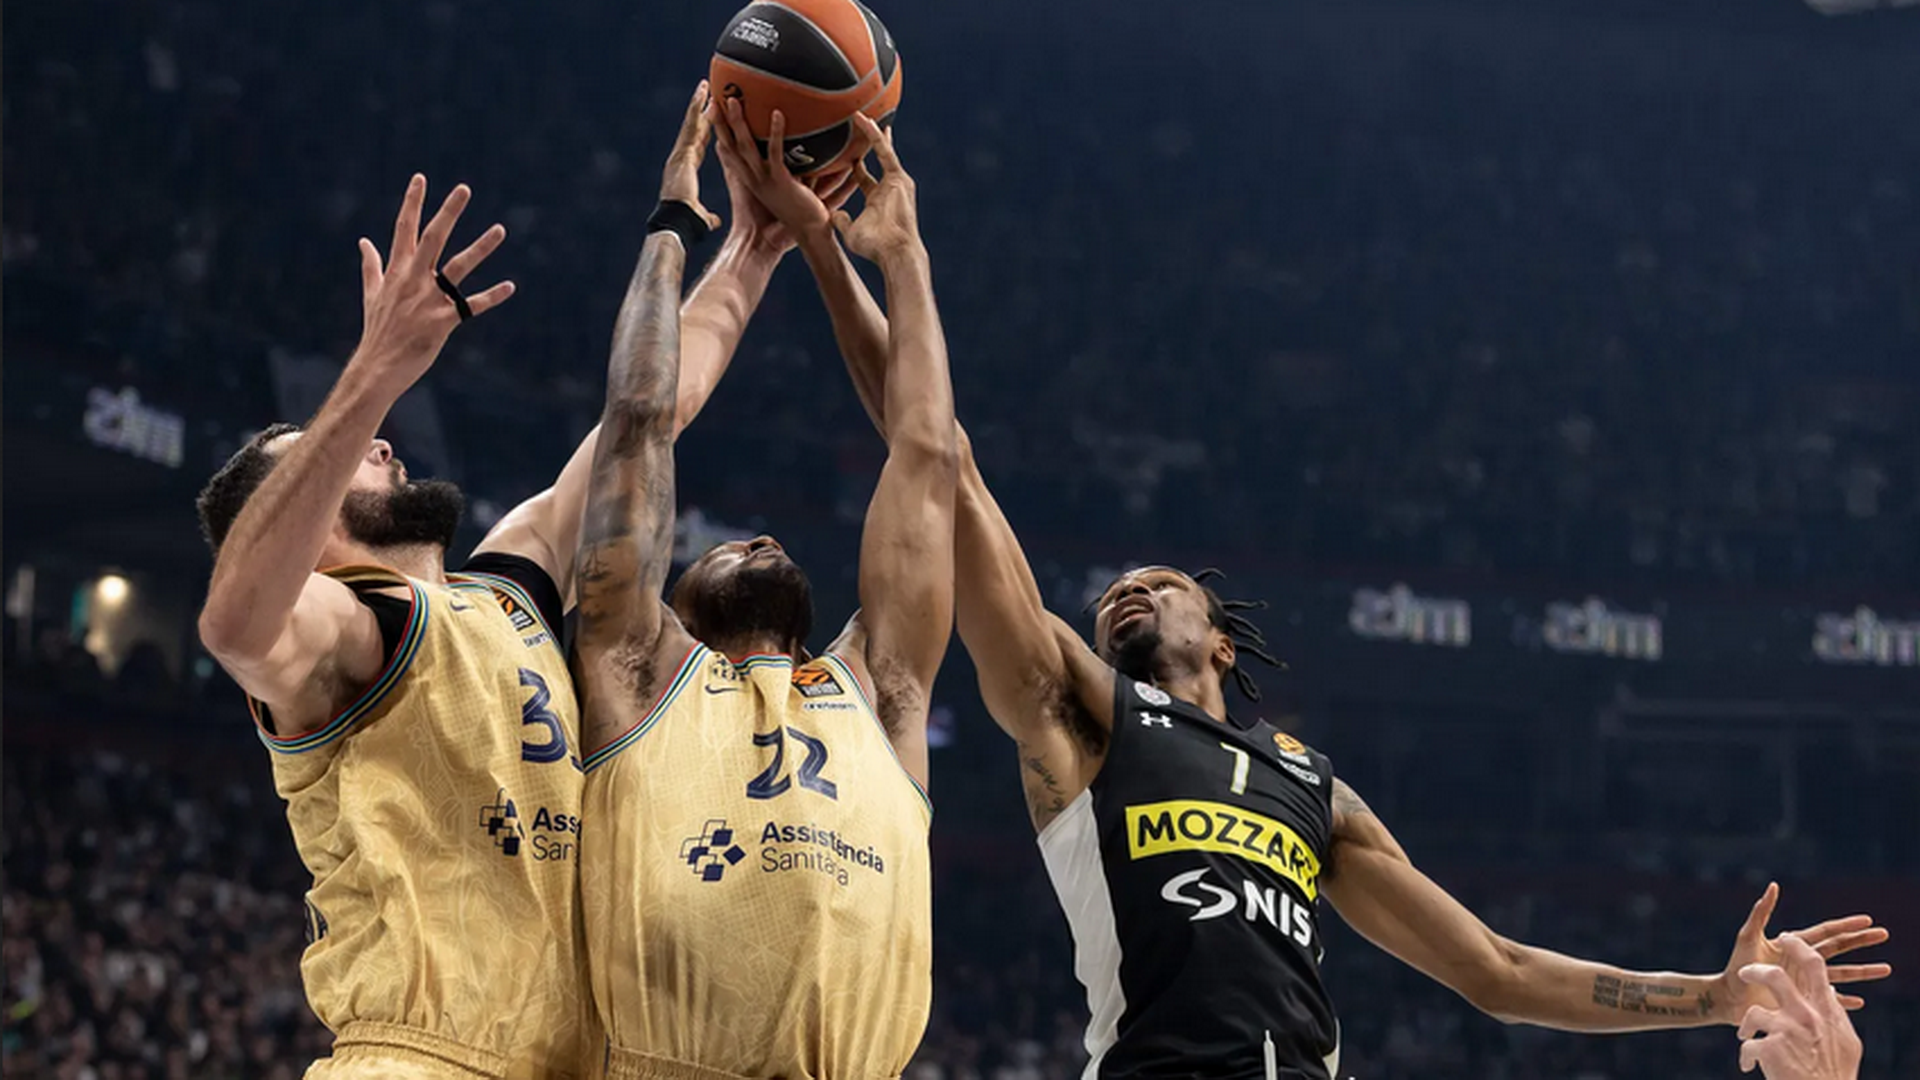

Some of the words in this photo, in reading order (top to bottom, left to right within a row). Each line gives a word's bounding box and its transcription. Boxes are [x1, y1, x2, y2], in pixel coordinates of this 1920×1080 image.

[519, 667, 584, 773] 3
[746, 724, 837, 800] 22
[1220, 742, 1249, 795] 7
[531, 807, 582, 842] Ass
[1243, 879, 1312, 947] NIS
